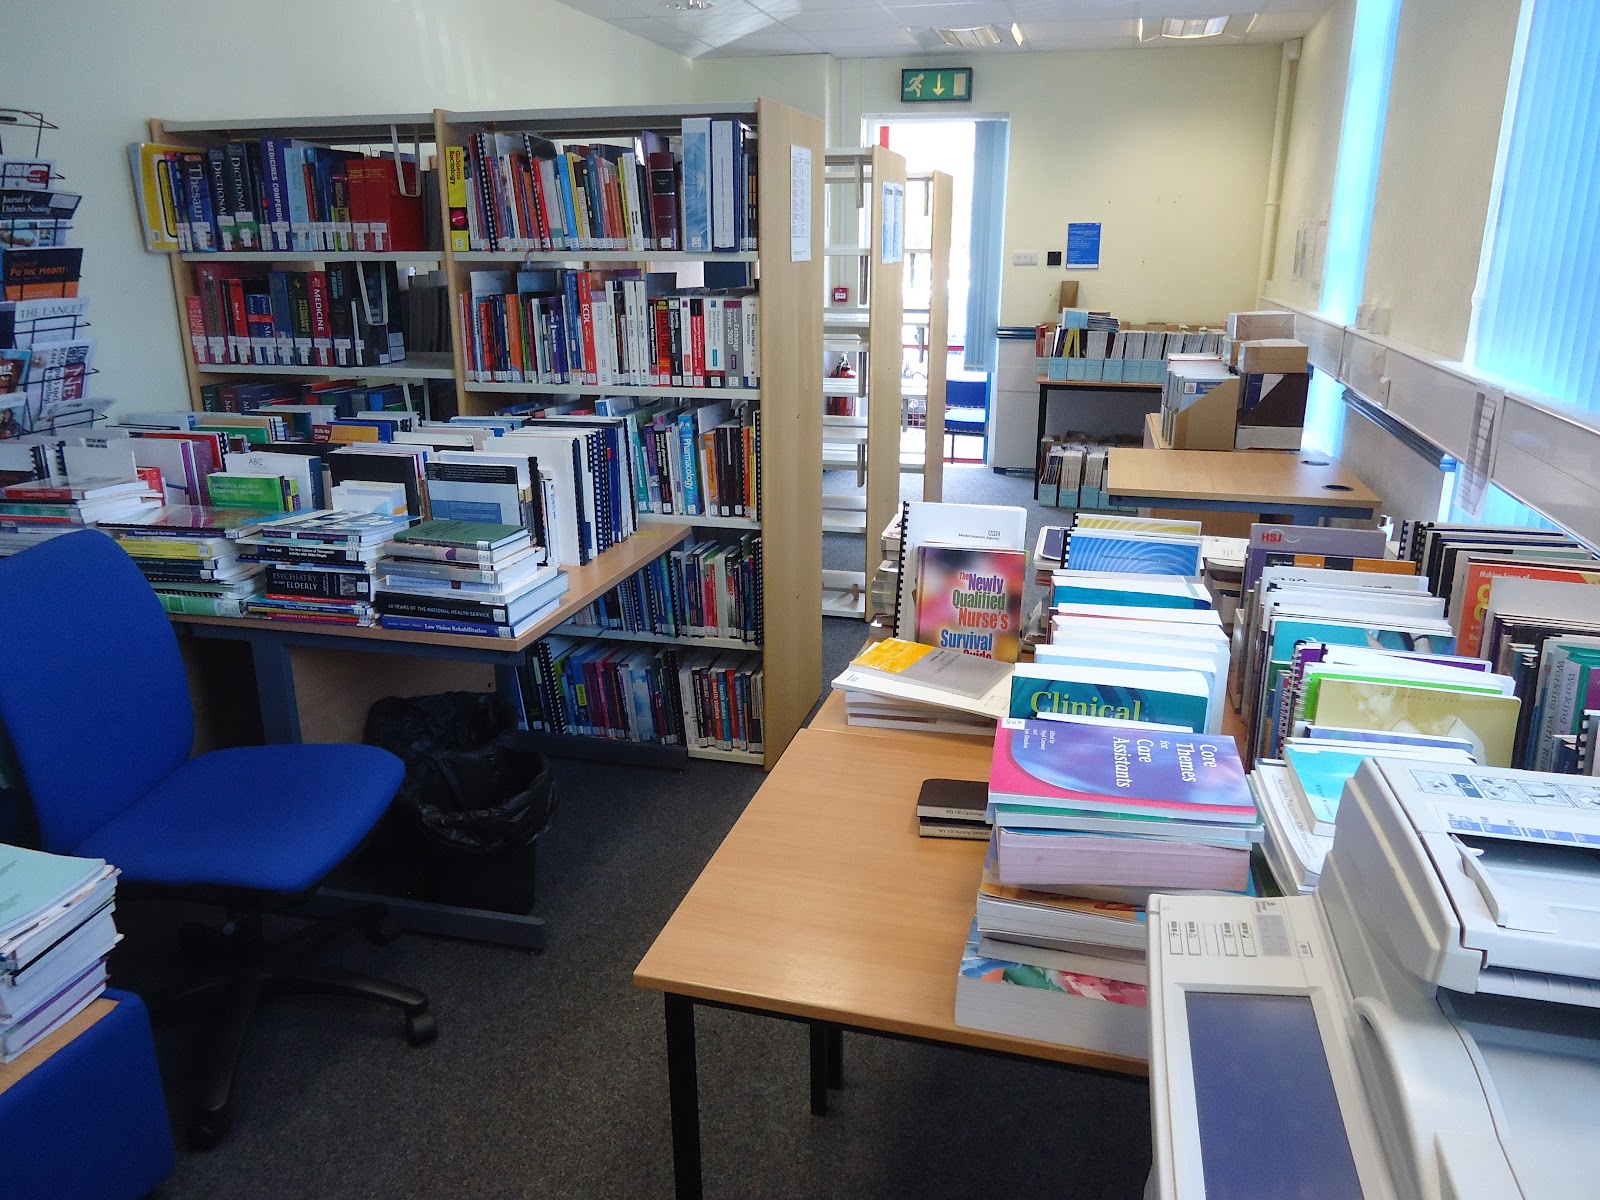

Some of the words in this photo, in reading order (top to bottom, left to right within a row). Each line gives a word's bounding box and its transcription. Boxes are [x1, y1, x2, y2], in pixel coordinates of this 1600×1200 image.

[267, 141, 278, 180] MEDICINES
[189, 164, 203, 222] Thesaur
[272, 183, 283, 222] COMPENDI
[10, 267, 36, 276] Pulic
[20, 309, 38, 318] THE
[42, 304, 83, 316] LANCET
[313, 289, 325, 331] MEDICINE
[249, 458, 263, 466] ABC
[683, 438, 695, 489] Pharmacology
[1261, 533, 1282, 542] HSJ
[272, 572, 317, 582] PSYCHIATRY
[286, 581, 318, 591] ELDERLY
[960, 571, 969, 580] The
[968, 573, 1004, 594] Newly
[427, 607, 450, 615] NATIONAL
[952, 589, 1006, 611] Qualified
[452, 625, 487, 634] Rehabilitation
[958, 608, 1009, 630] Nurse's
[940, 629, 993, 651] Survival
[1549, 661, 1565, 711] Working
[1031, 691, 1141, 721] Clinical
[1560, 673, 1576, 725] Working
[1544, 716, 1554, 742] with
[1136, 738, 1154, 763] Care
[1160, 740, 1170, 749] for
[1200, 743, 1218, 768] Core
[1113, 736, 1130, 788] Assistants
[1176, 742, 1196, 783] Themes
